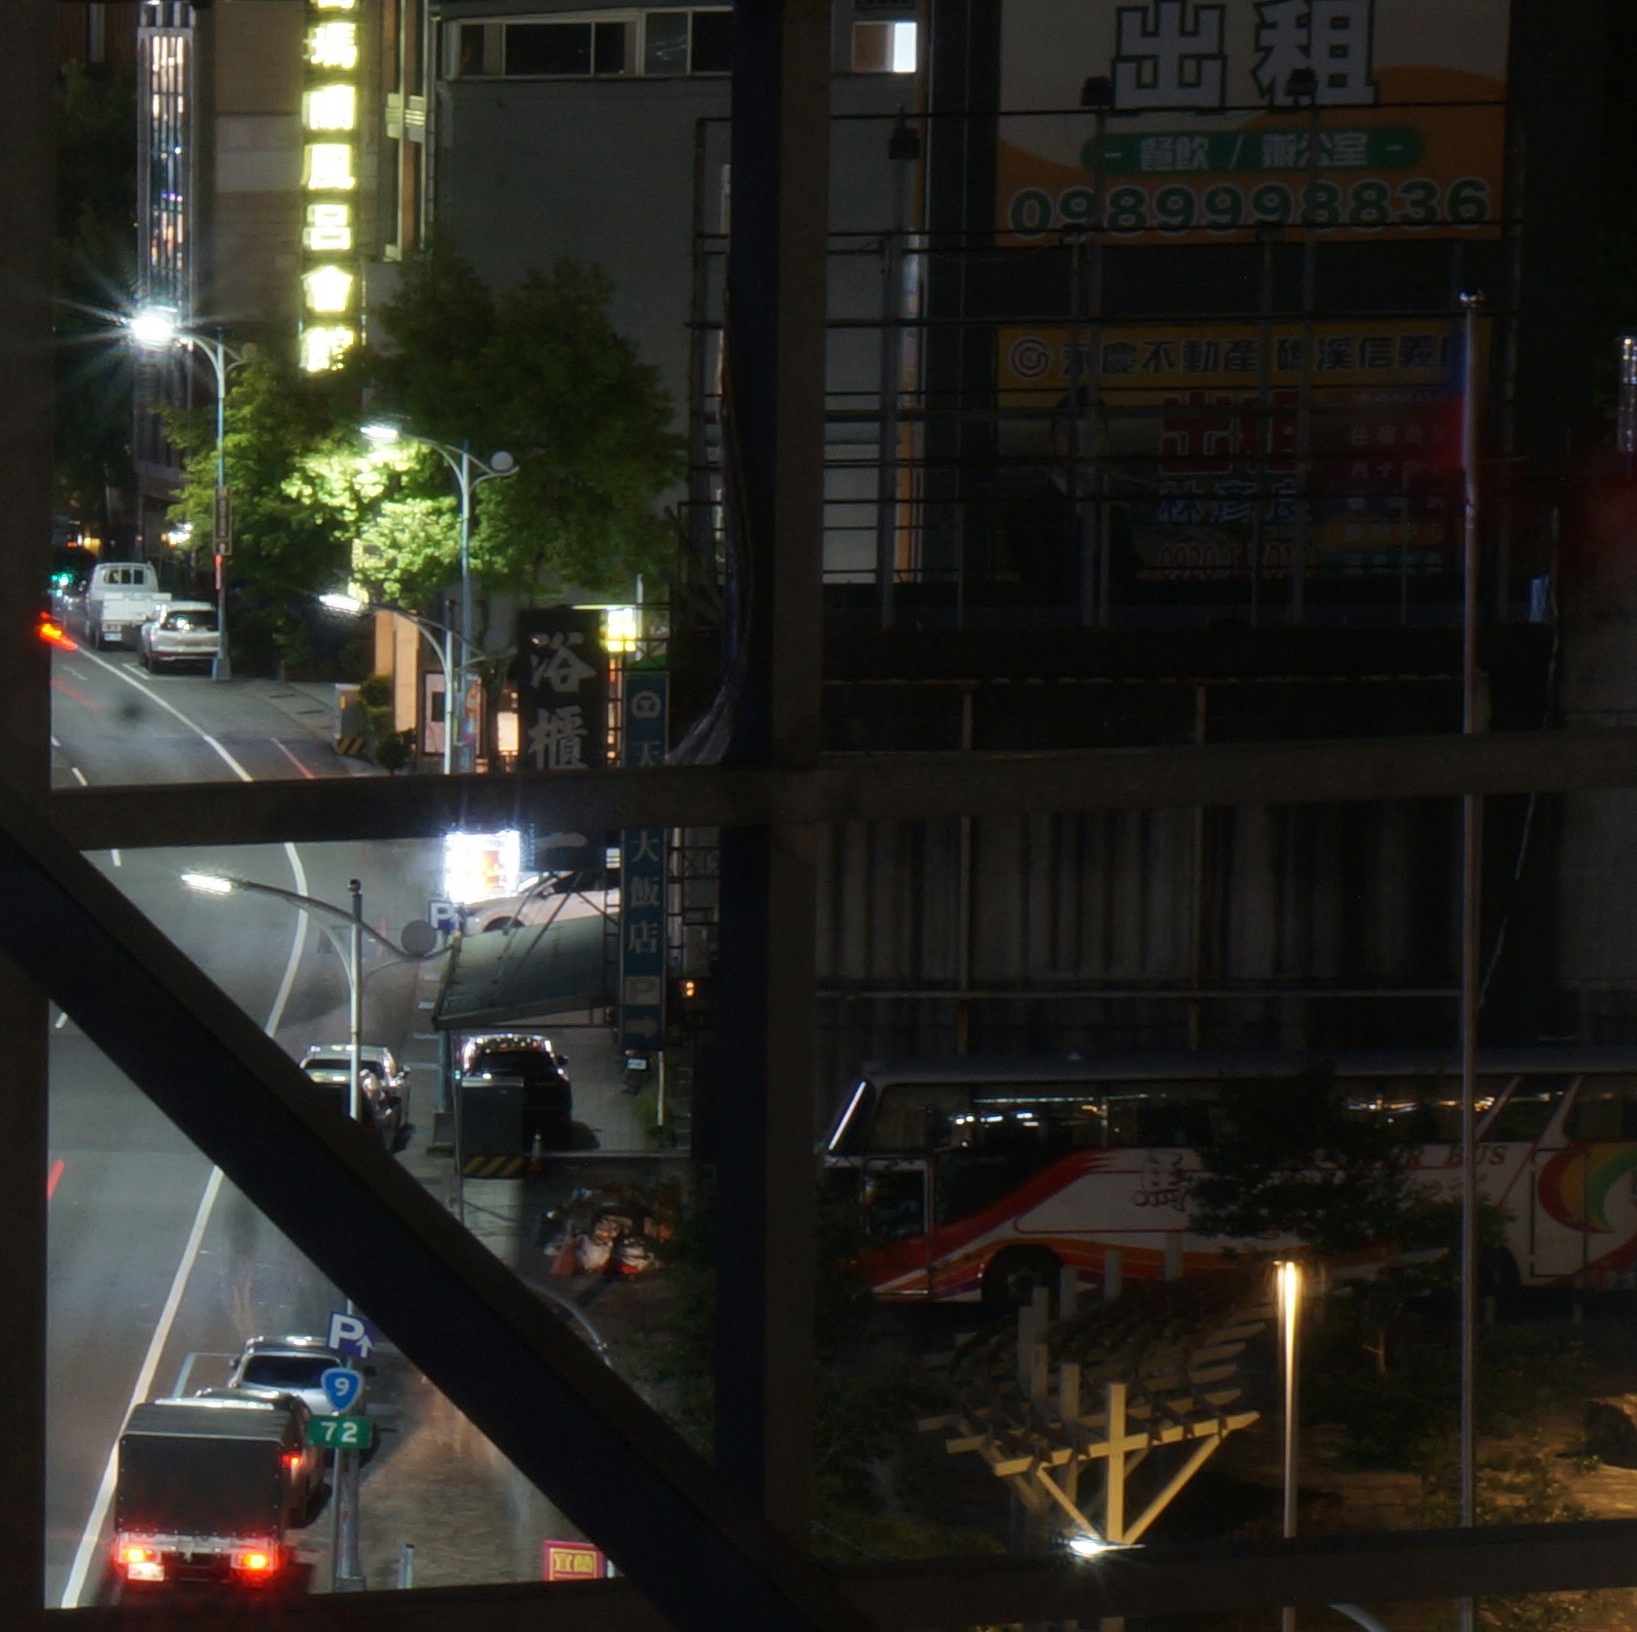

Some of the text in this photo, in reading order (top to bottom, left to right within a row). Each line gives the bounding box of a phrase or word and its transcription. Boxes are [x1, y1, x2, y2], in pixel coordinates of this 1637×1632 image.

[1112, 0, 1378, 110] 出租
[1262, 132, 1368, 168] 辦公室
[1009, 177, 1491, 238] 0989998836
[629, 741, 661, 954] 天大飯店
[328, 1313, 365, 1350] P
[334, 1377, 350, 1397] 9
[321, 1421, 358, 1444] 72
